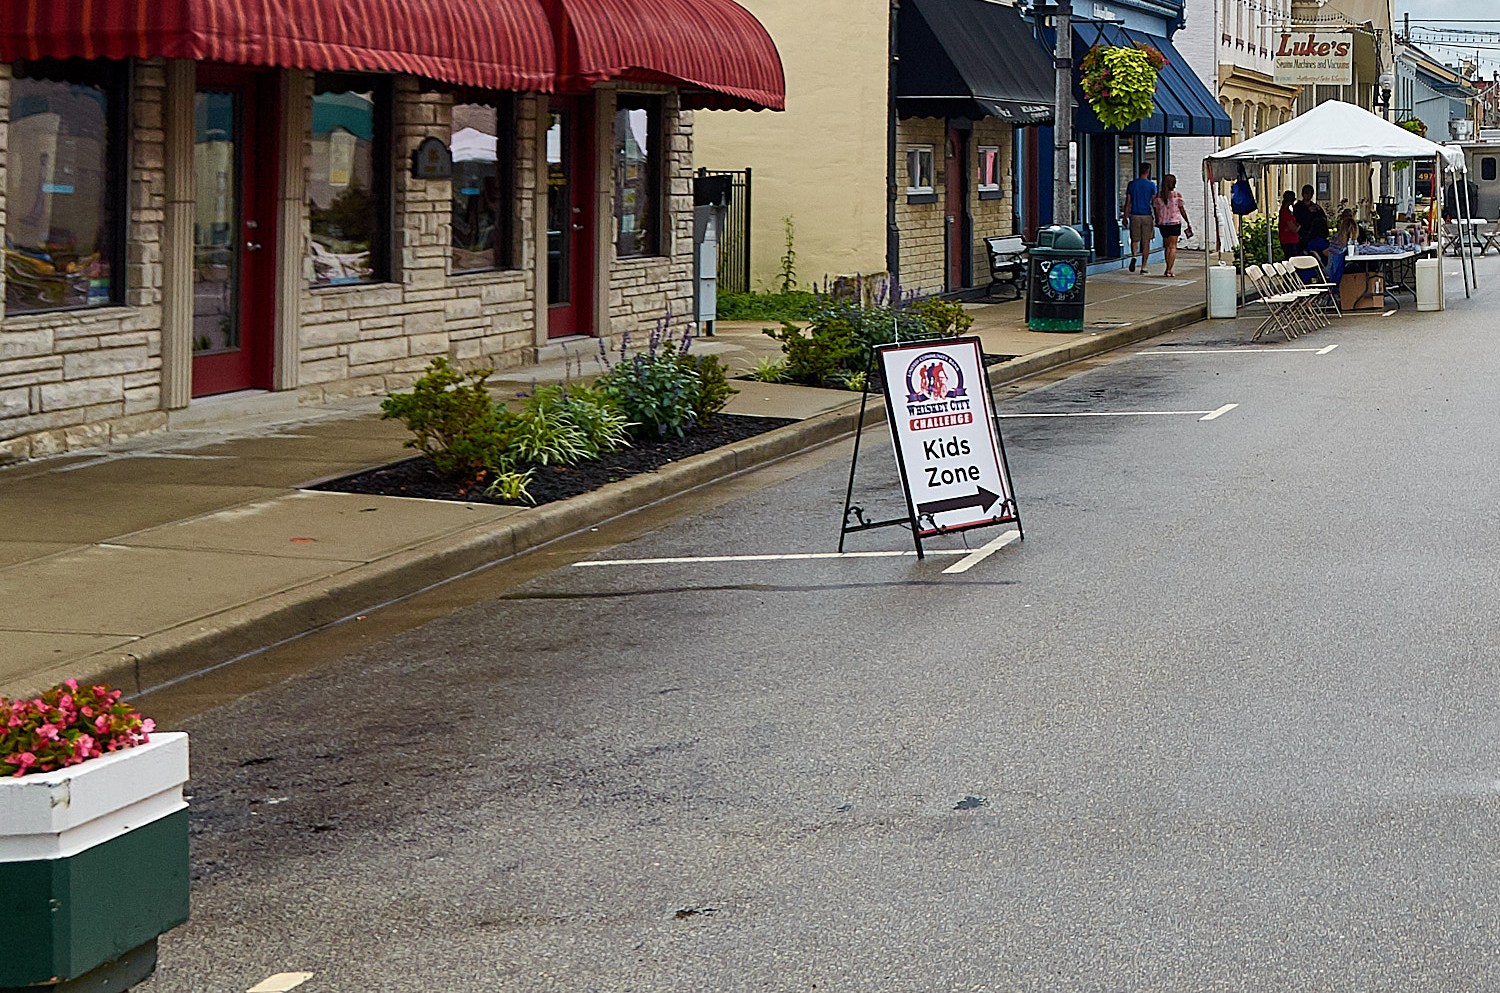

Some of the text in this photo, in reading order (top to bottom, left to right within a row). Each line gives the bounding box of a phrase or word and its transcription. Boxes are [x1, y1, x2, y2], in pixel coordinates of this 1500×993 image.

[1276, 34, 1351, 57] Luke's
[906, 399, 971, 416] WHISKEY CITY
[913, 413, 970, 430] CHALLENGE
[923, 435, 971, 460] Kids
[924, 465, 980, 487] Zone
